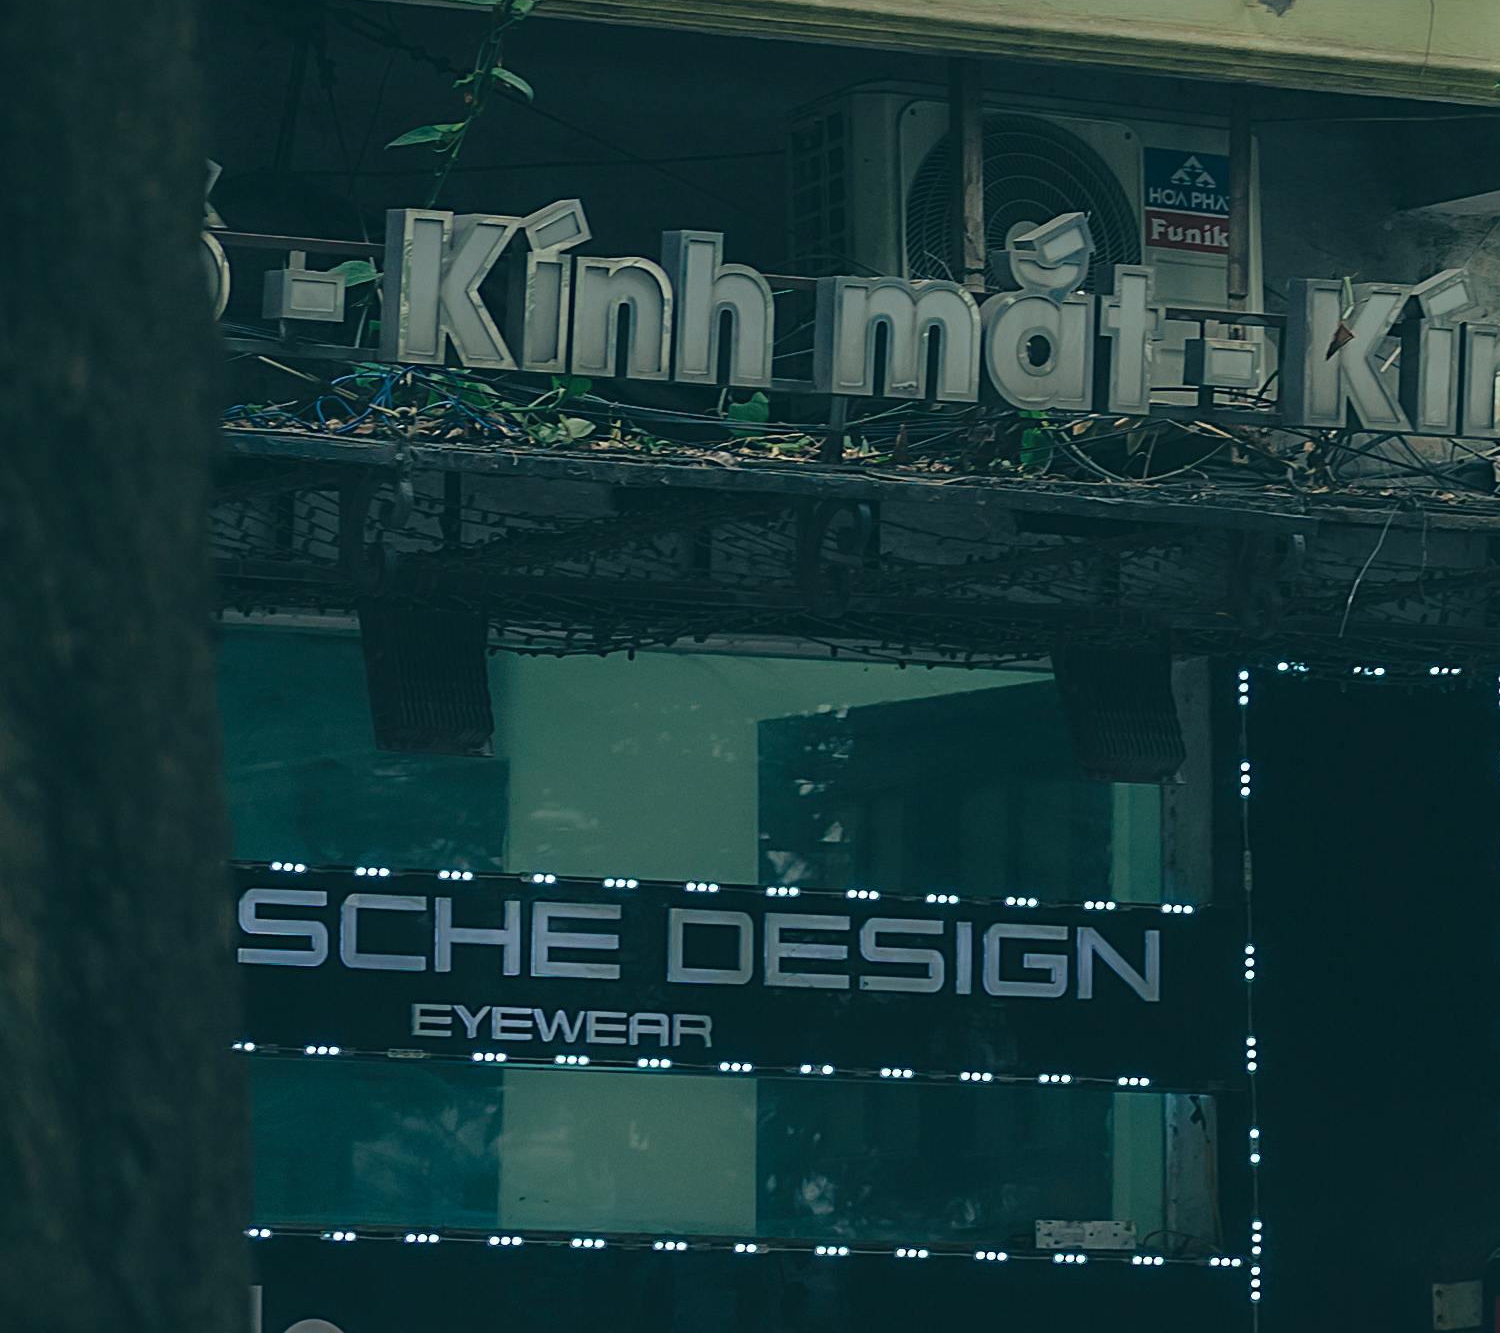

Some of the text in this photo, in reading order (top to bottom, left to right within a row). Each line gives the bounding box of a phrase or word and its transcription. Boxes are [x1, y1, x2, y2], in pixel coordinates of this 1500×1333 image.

[1149, 187, 1230, 211] HOA PHA
[388, 199, 775, 388] Kính
[822, 211, 1156, 415] mắt
[237, 888, 1161, 1002] SCHE DESIGN
[412, 1004, 712, 1049] EYEWEAR
